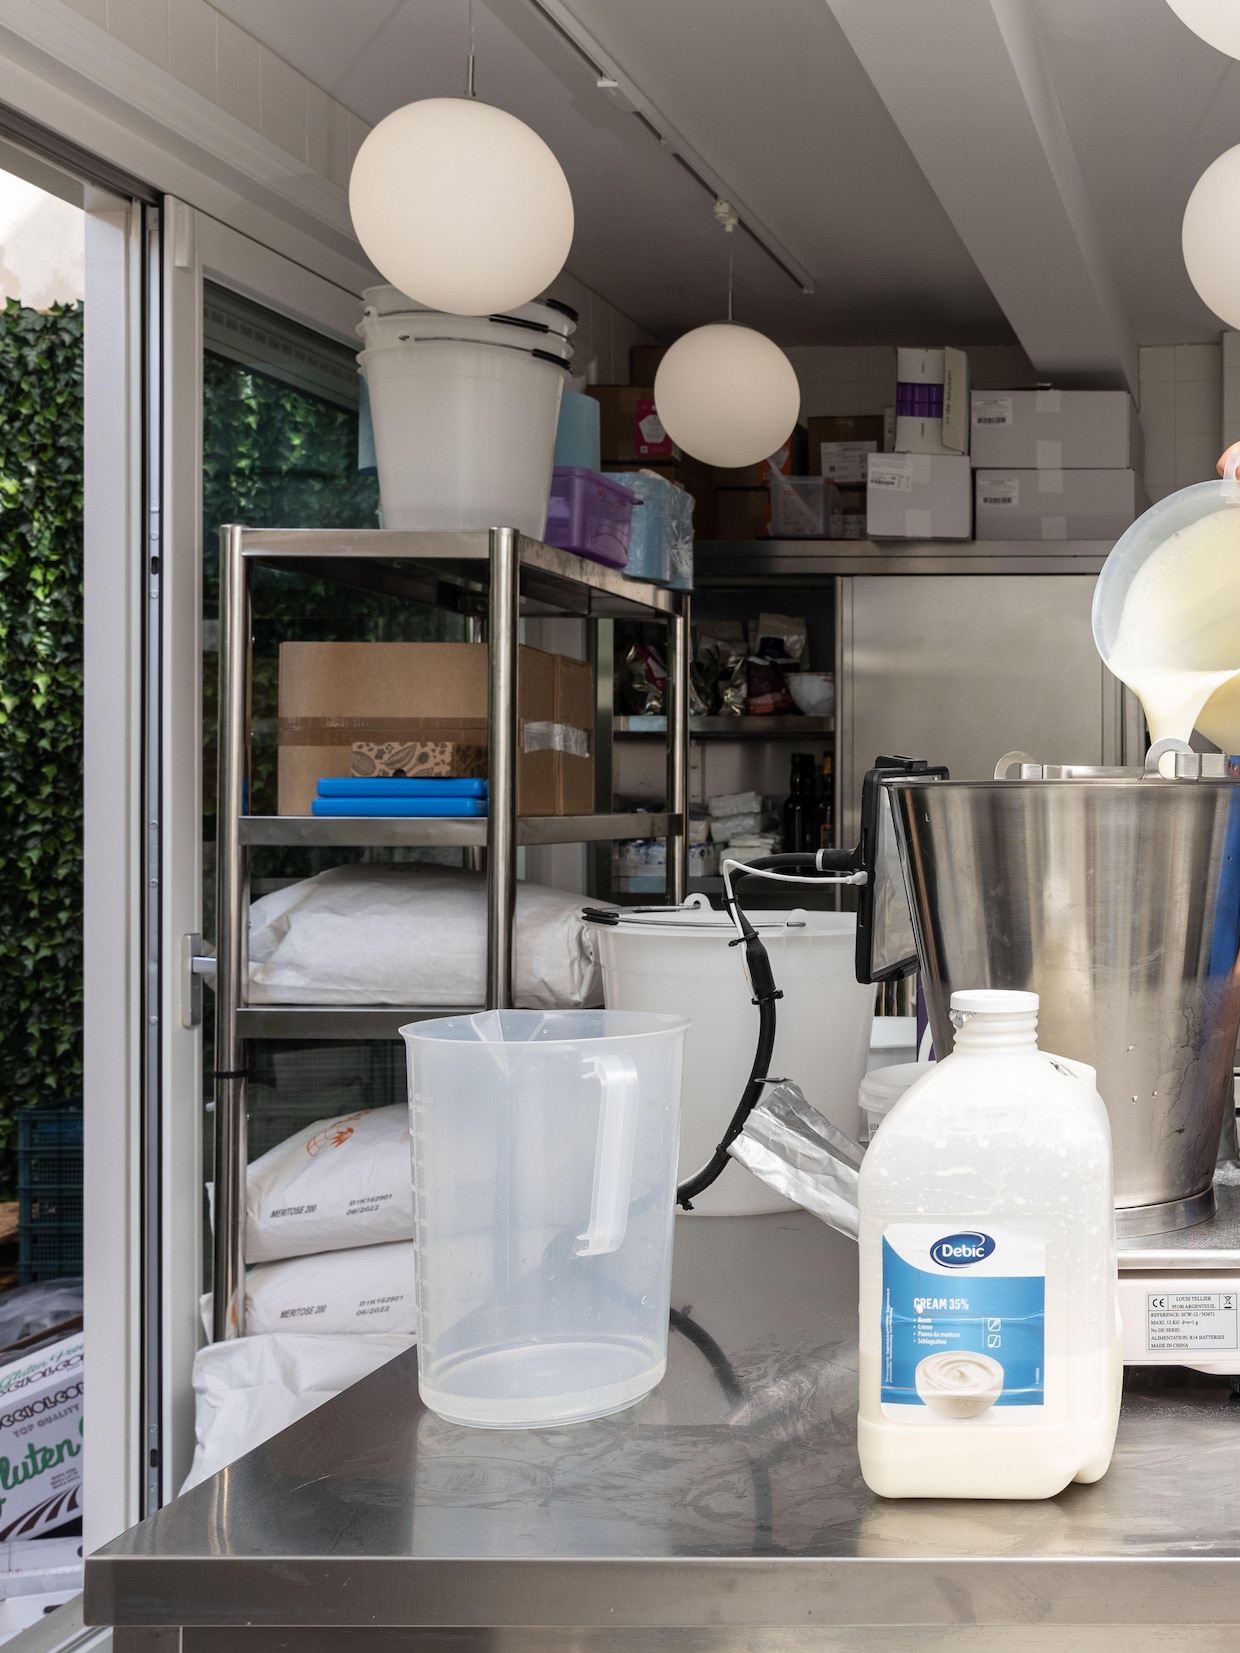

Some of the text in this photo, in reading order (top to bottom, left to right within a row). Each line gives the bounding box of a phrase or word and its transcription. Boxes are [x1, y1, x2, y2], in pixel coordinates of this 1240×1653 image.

[270, 1204, 317, 1218] MERITOSE 200
[346, 1204, 380, 1216] 06/2022
[942, 1244, 984, 1258] Debic
[356, 1306, 390, 1316] 06/2022
[914, 1298, 970, 1310] CREAM 35%
[280, 1305, 326, 1319] MERITOSE 200
[13, 1424, 34, 1438] TOP
[37, 1403, 80, 1427] QUALITY
[0, 1438, 81, 1491] luten
